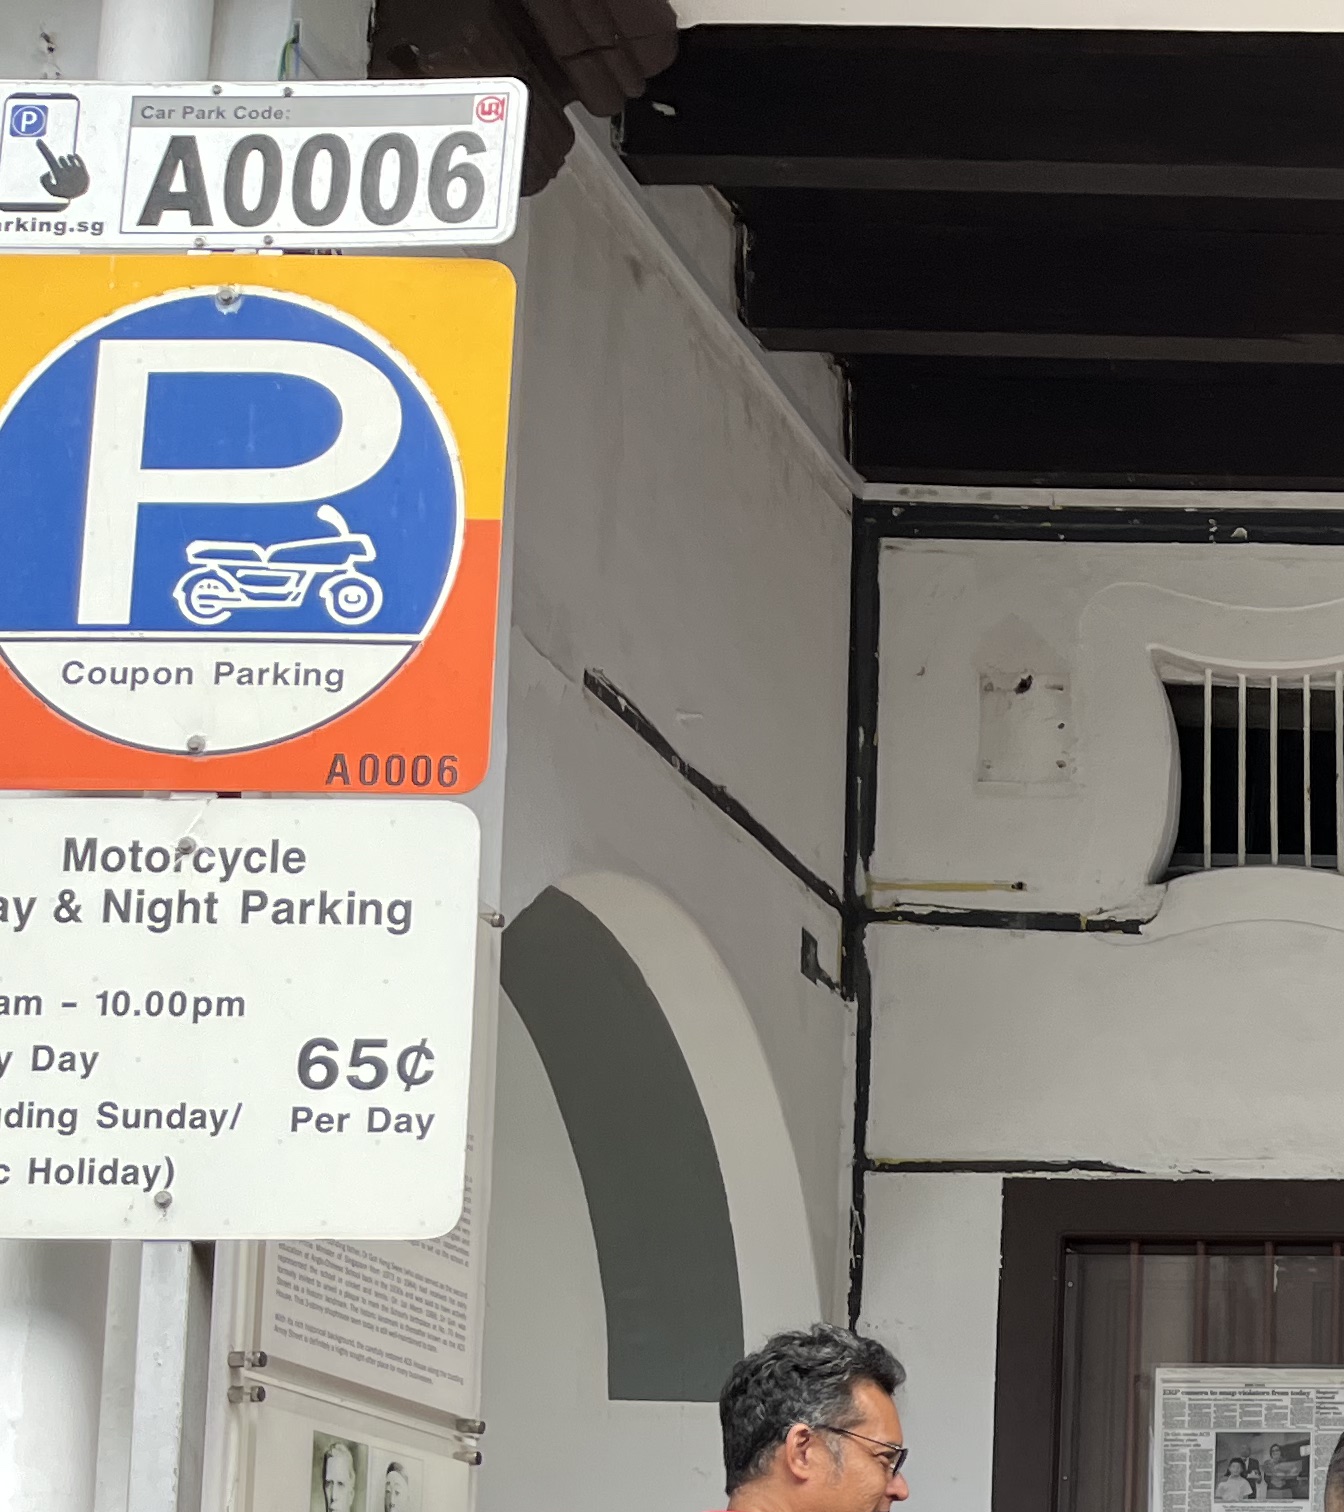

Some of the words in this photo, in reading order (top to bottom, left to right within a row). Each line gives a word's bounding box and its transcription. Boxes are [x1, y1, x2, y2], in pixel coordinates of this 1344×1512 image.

[140, 104, 175, 121] Car
[182, 104, 226, 121] Park
[233, 104, 291, 121] Code:
[136, 131, 487, 229] A0006
[0, 216, 104, 236] rking.sg
[78, 339, 402, 624] P
[61, 660, 194, 691] Coupon
[213, 660, 345, 693] Parking
[325, 753, 459, 787] A0006
[63, 837, 307, 882] Motorcycle
[53, 888, 82, 924] &
[102, 888, 218, 934] Night
[240, 889, 413, 935] Parking
[96, 989, 245, 1024] 10.00pm
[31, 1045, 99, 1079] Day
[297, 1037, 435, 1092] 65¢
[0, 1101, 78, 1136] ding
[96, 1101, 242, 1137] Sunday/
[291, 1106, 350, 1134] Per
[366, 1106, 435, 1140] Day
[28, 1157, 175, 1192] Holiday)
